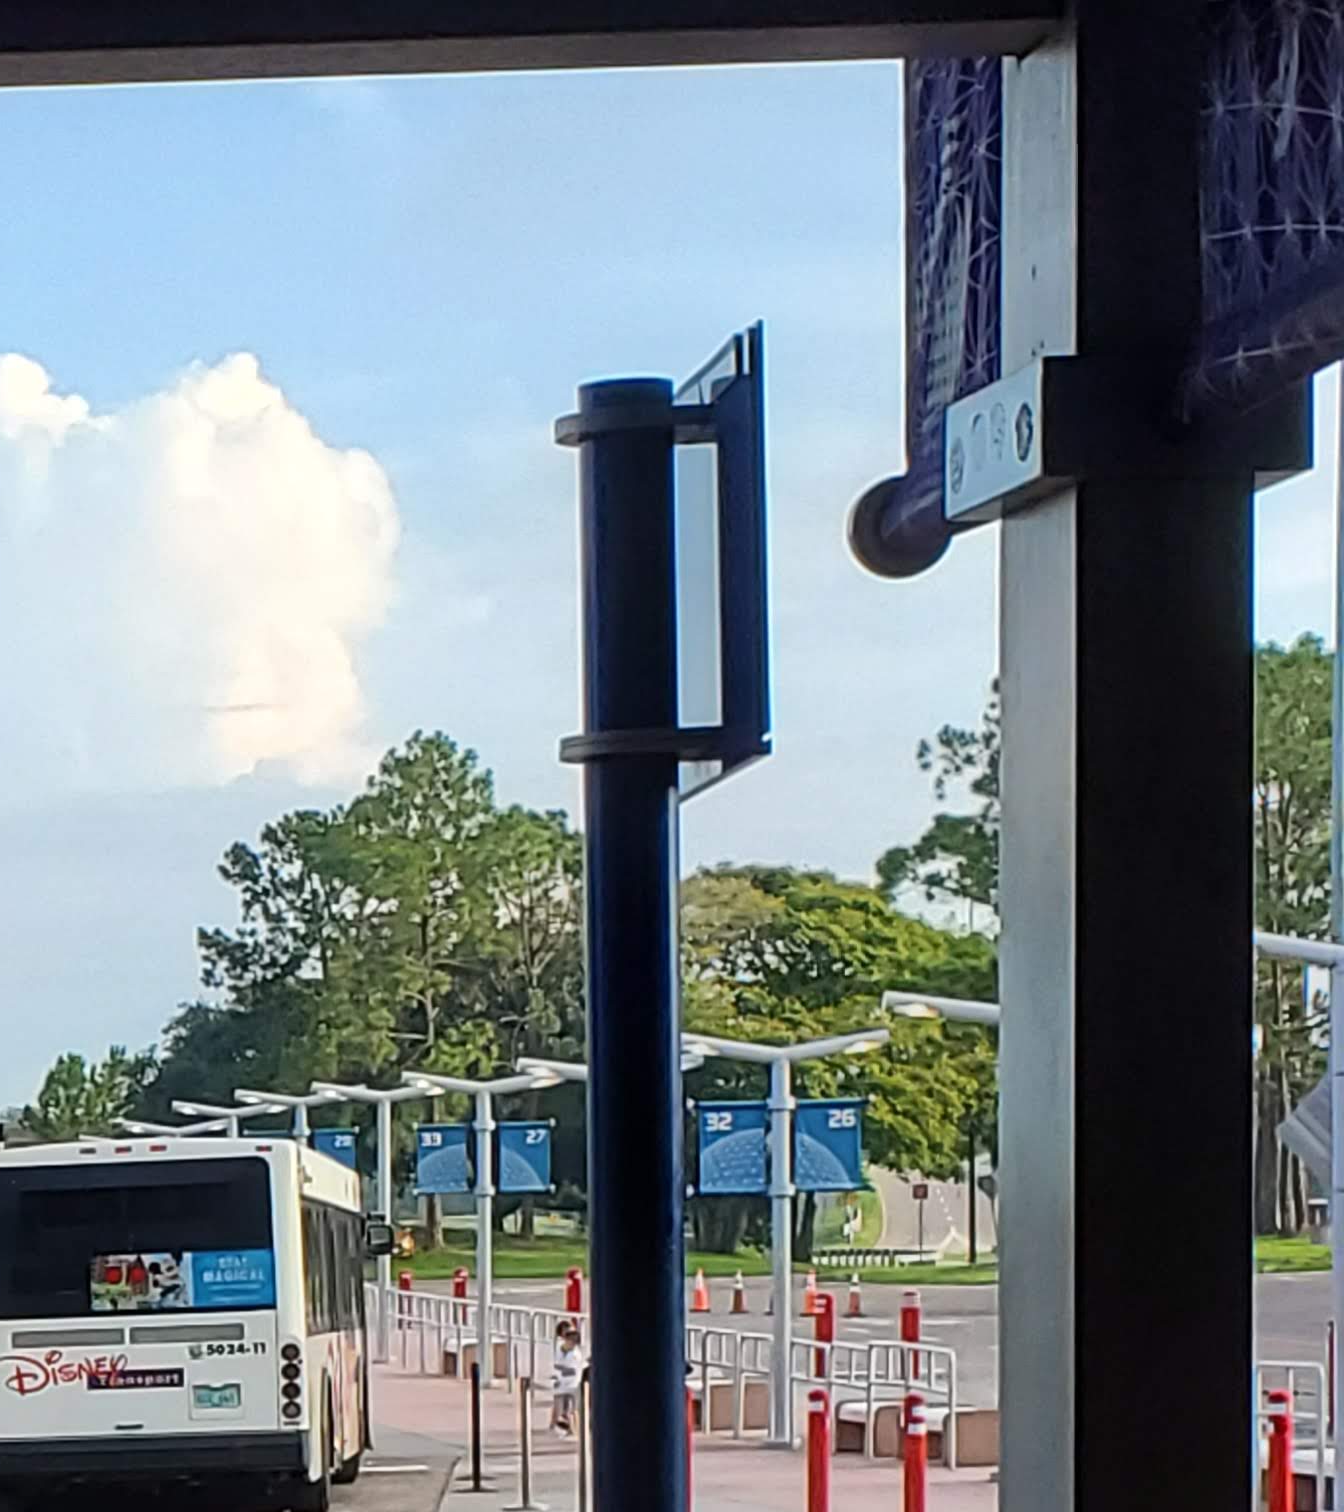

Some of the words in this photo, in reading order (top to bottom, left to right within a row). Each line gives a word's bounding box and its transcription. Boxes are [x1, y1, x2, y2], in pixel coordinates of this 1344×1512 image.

[704, 1111, 732, 1132] 32
[828, 1108, 856, 1128] 26
[525, 1129, 547, 1144] 27
[206, 1342, 267, 1356] 5024-11
